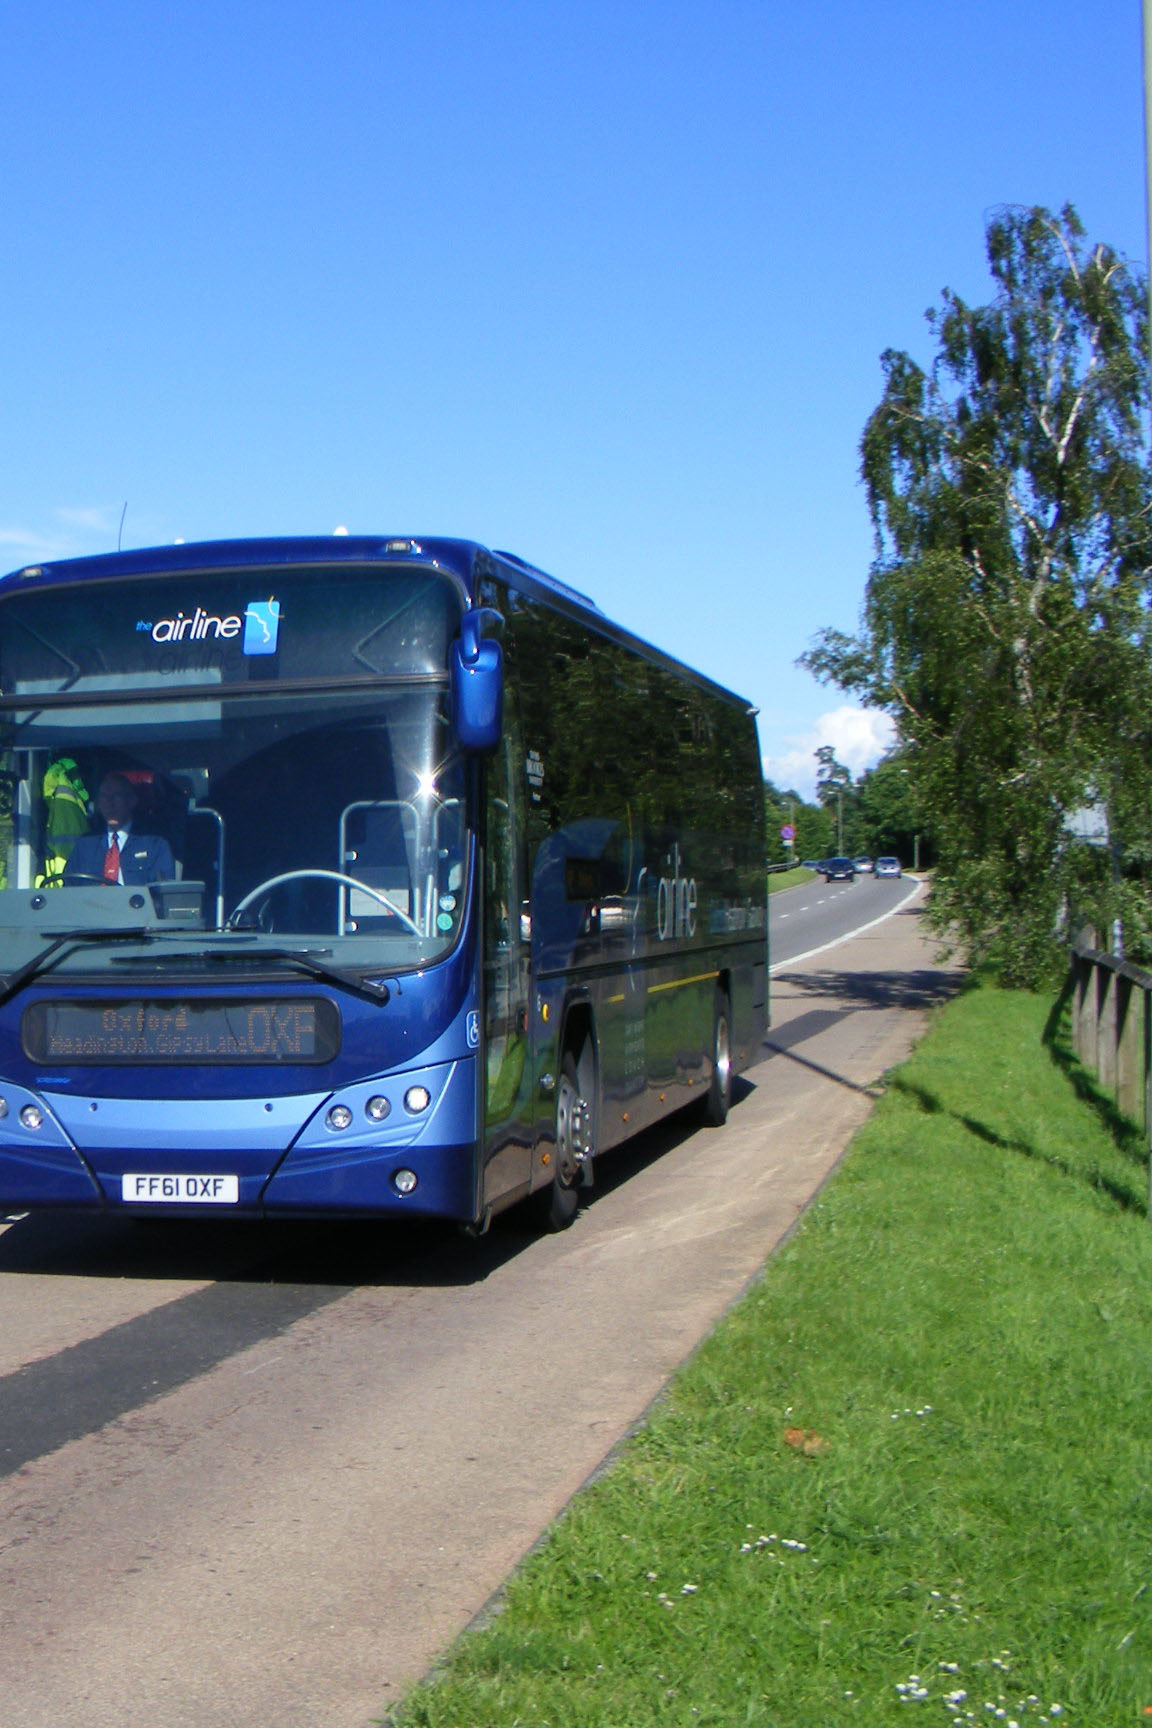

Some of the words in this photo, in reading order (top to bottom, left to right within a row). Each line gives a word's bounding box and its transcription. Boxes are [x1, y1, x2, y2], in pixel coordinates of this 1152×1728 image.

[136, 620, 152, 631] the
[152, 607, 242, 643] airline
[248, 1006, 315, 1053] OXF
[136, 1177, 179, 1196] FF61
[186, 1178, 224, 1196] OXF
